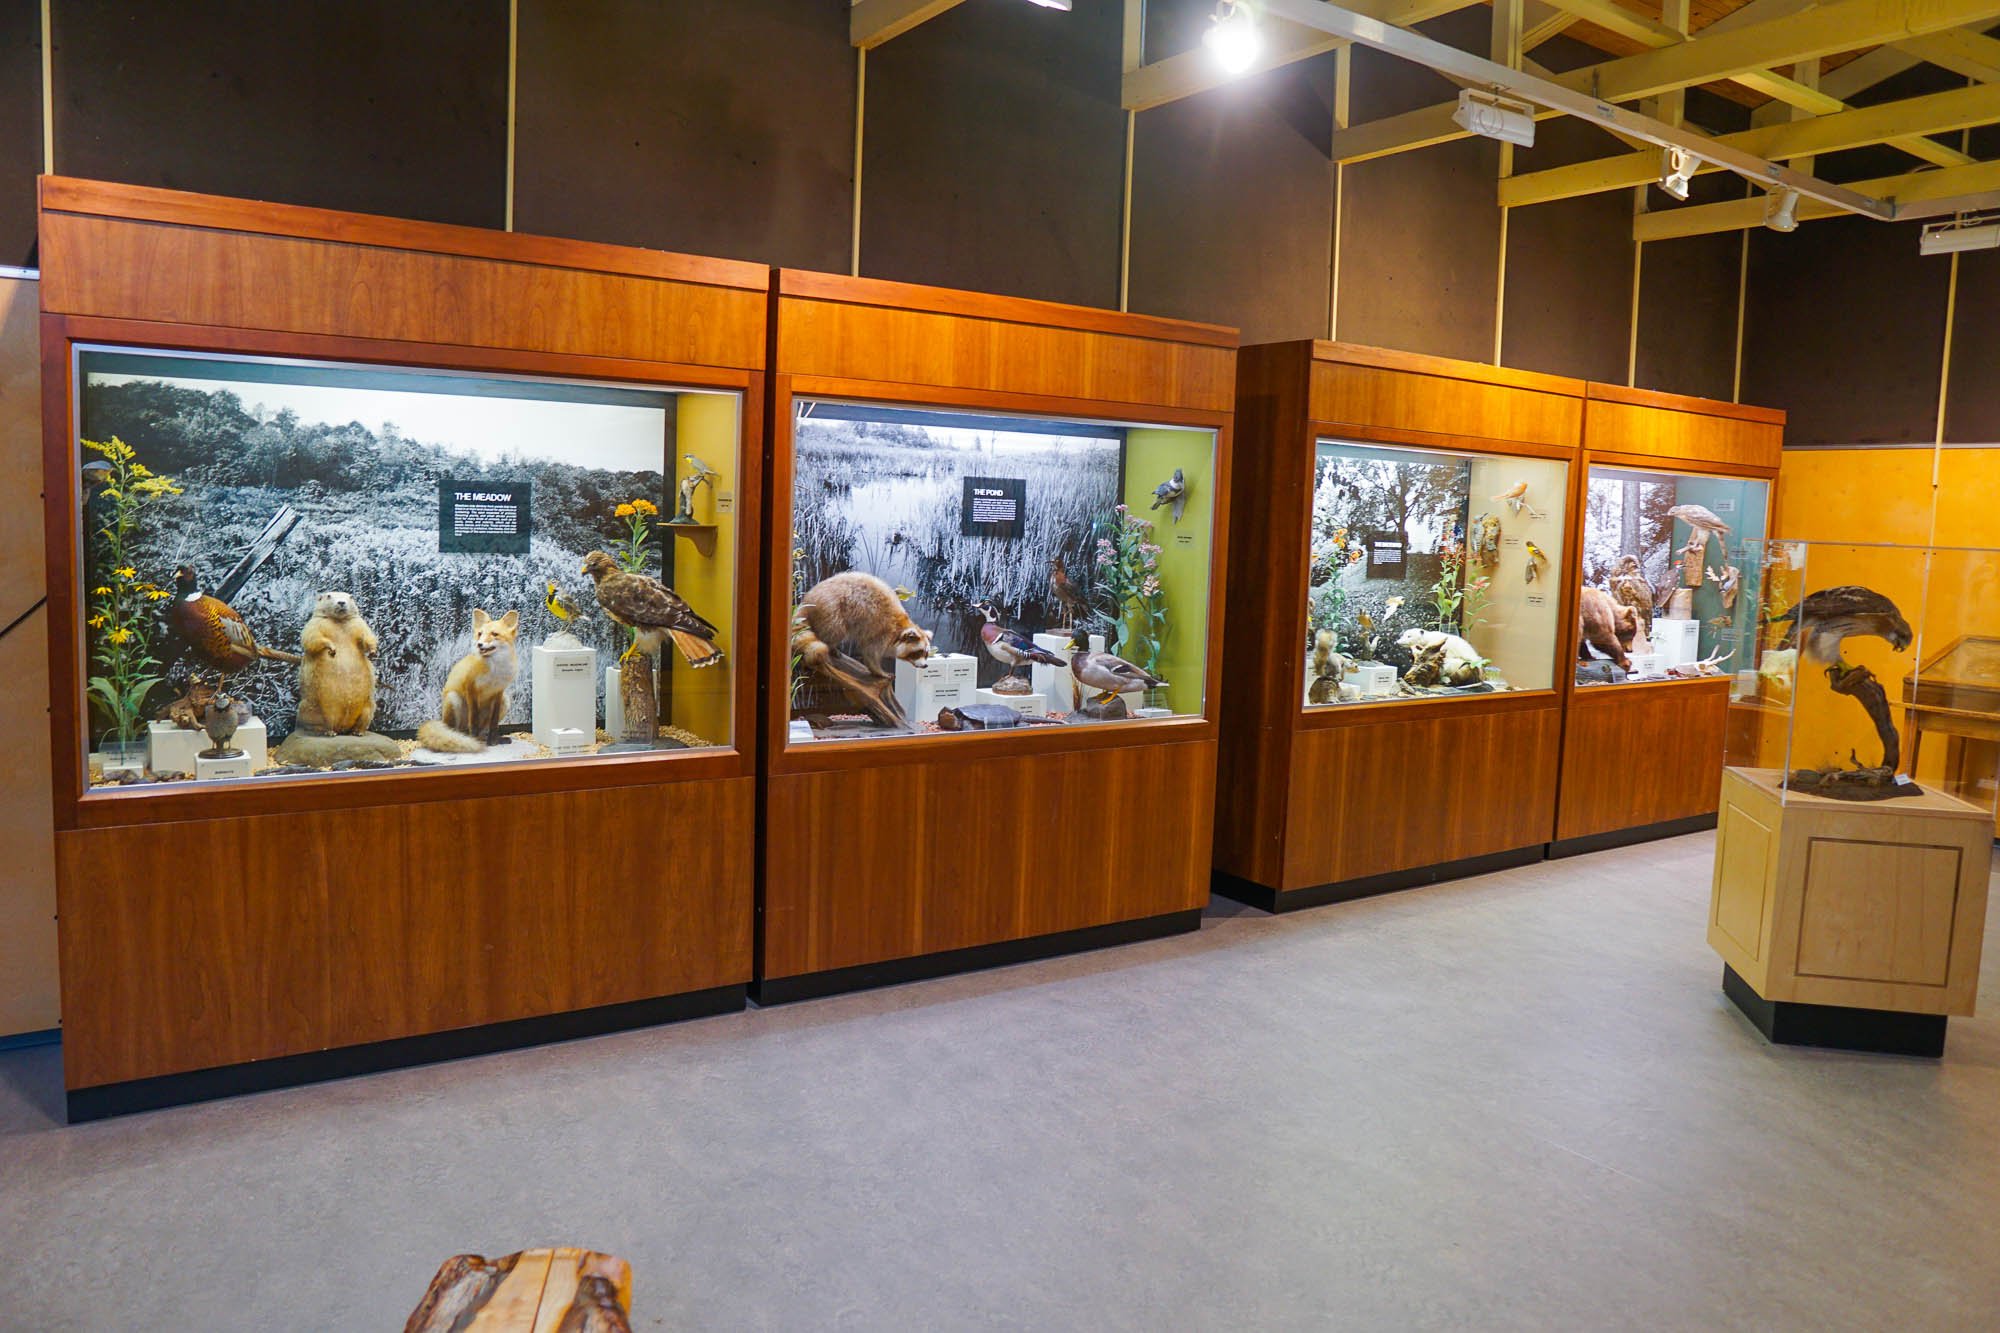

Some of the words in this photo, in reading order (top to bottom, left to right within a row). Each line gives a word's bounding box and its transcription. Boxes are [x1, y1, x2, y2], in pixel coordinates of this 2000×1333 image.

[454, 492, 472, 501] THE
[472, 493, 512, 502] MEADOW
[986, 489, 1004, 497] POND
